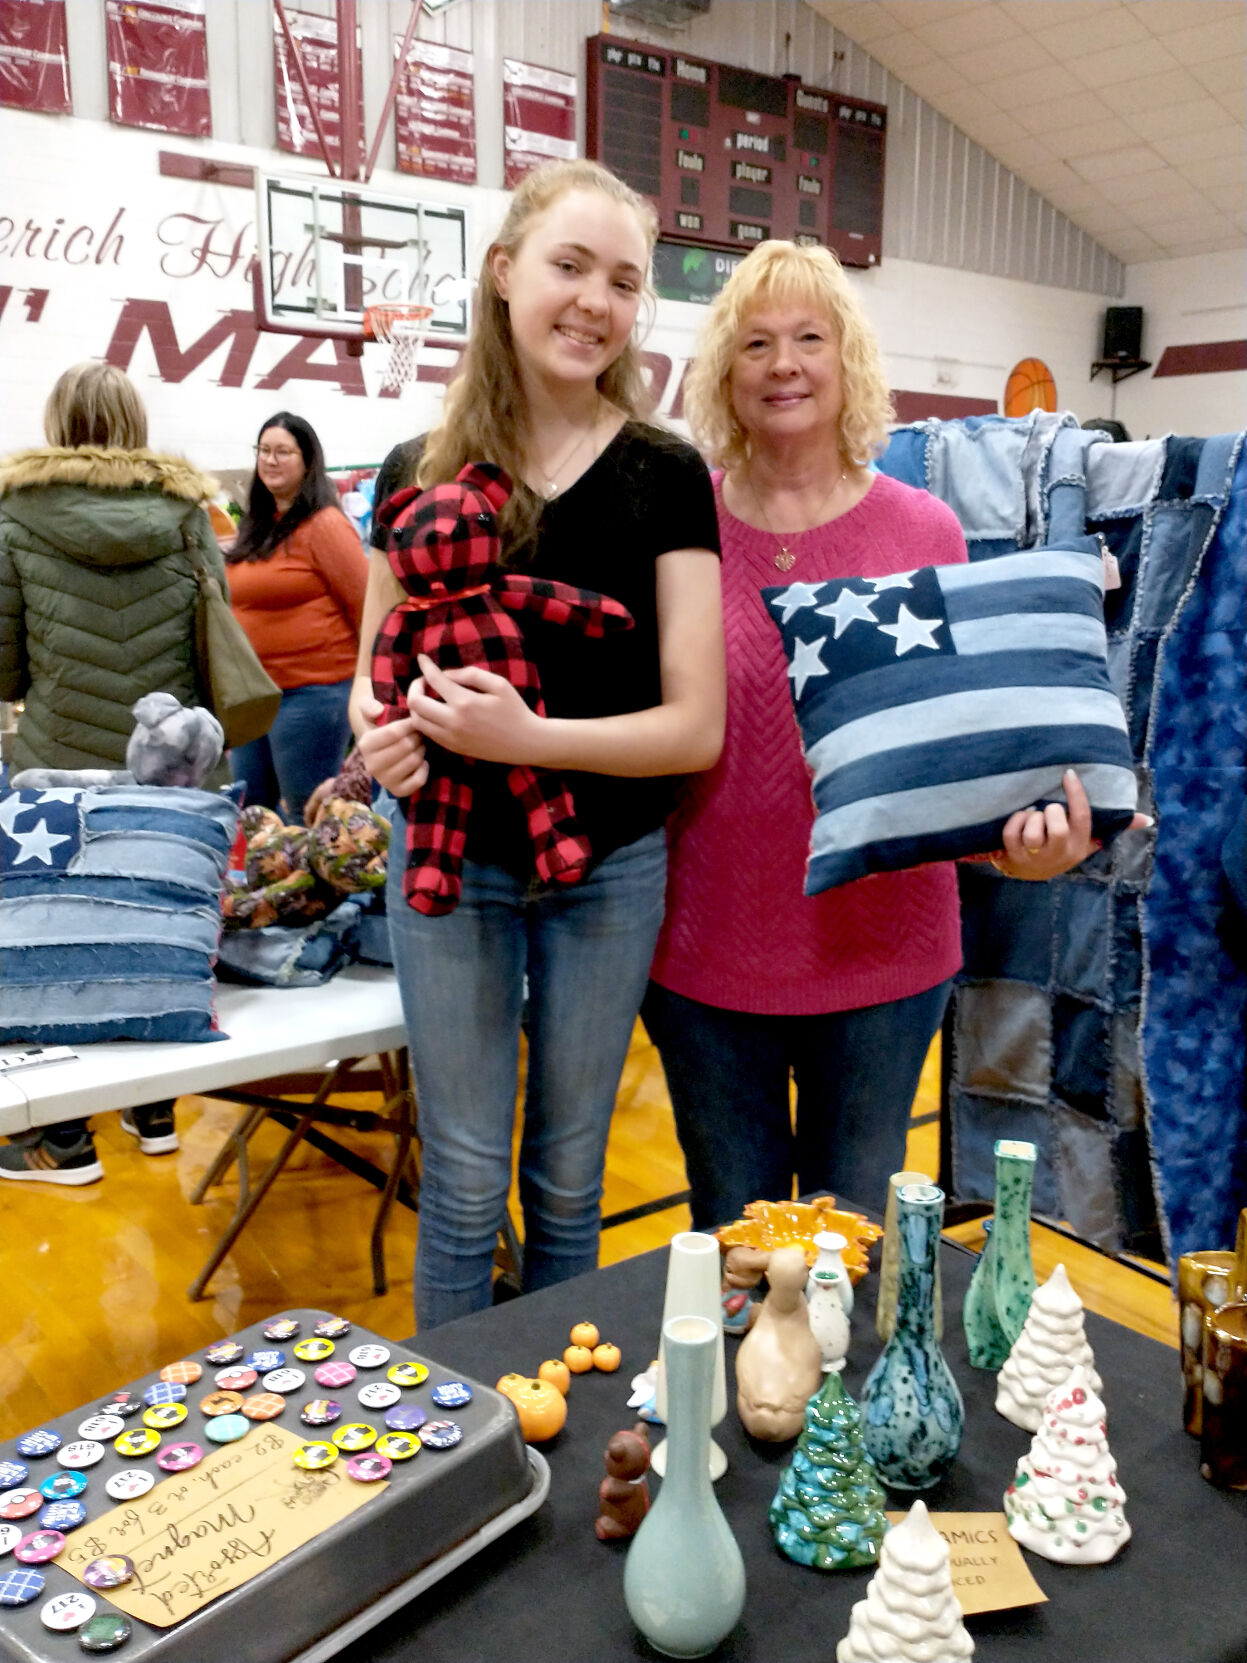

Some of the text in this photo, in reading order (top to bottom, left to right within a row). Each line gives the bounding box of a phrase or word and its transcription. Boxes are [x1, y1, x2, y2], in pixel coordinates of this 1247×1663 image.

[736, 133, 769, 152] period
[735, 162, 768, 183] player
[256, 1434, 284, 1456] $2
[167, 1486, 188, 1502] or
[147, 1502, 168, 1515] 3
[108, 1509, 146, 1536] for
[67, 1536, 108, 1563] $5
[150, 1528, 276, 1615] Assorted
